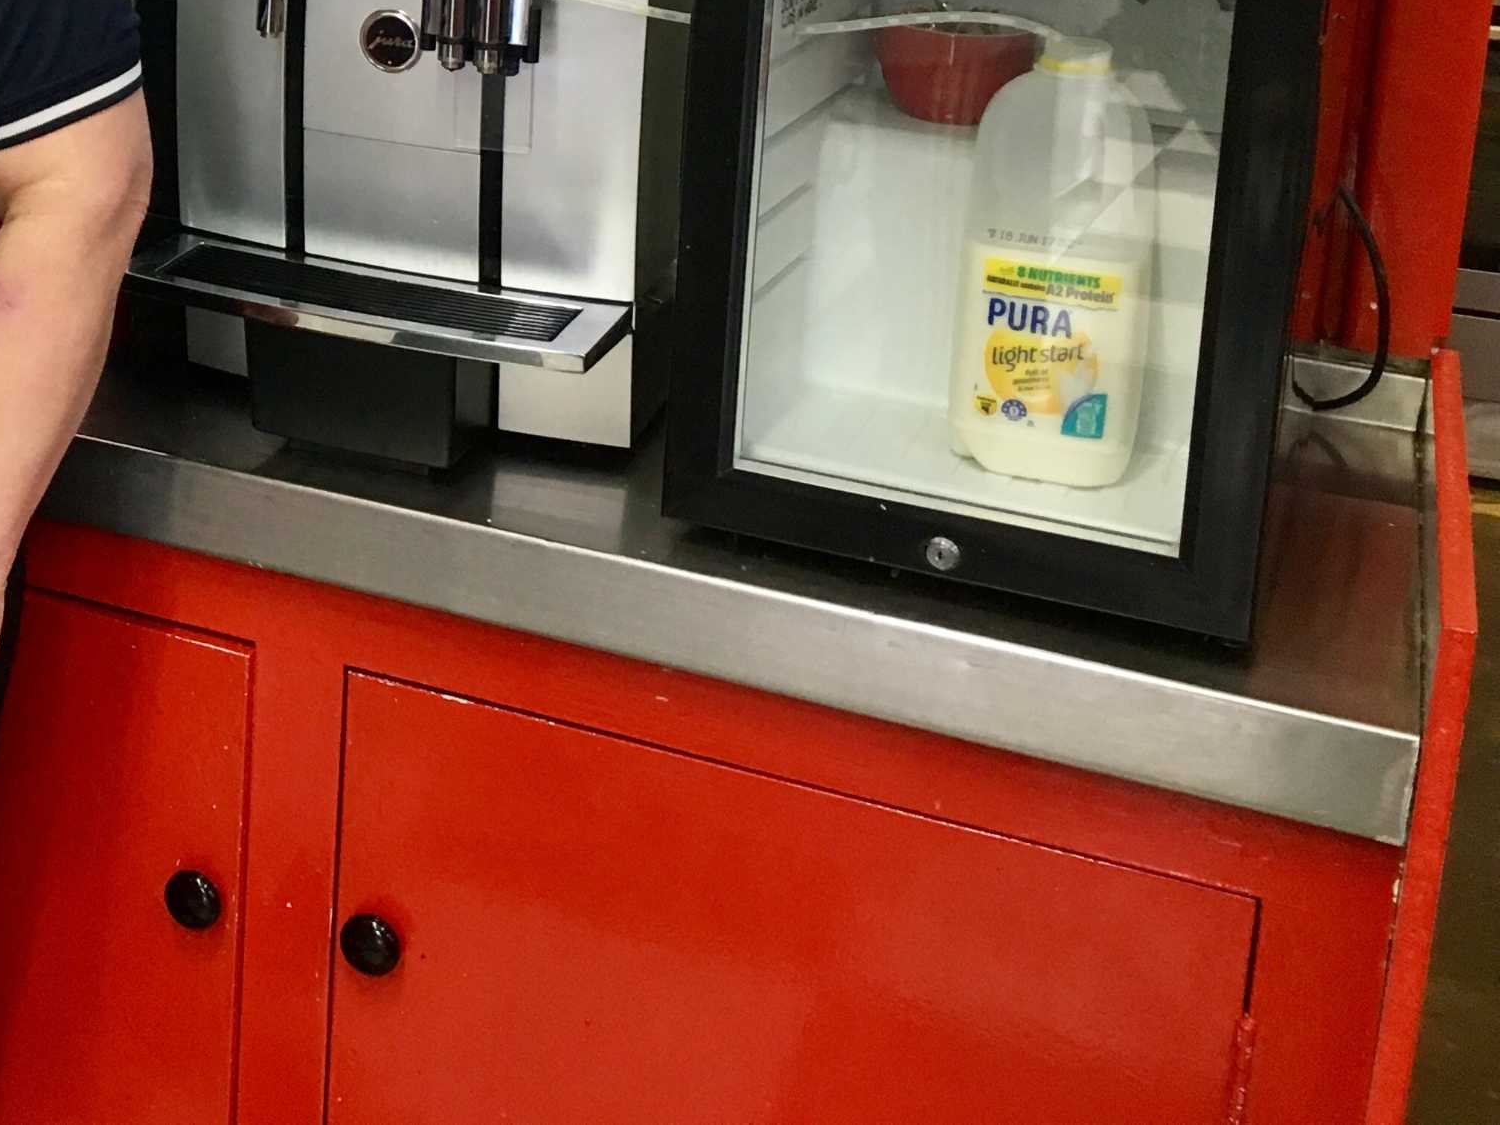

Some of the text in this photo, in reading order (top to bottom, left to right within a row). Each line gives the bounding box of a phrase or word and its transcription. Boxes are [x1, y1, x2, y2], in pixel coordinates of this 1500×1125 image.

[1028, 267, 1101, 289] NUTRIENTS
[987, 297, 1073, 339] PURA
[992, 342, 1085, 372] light start
